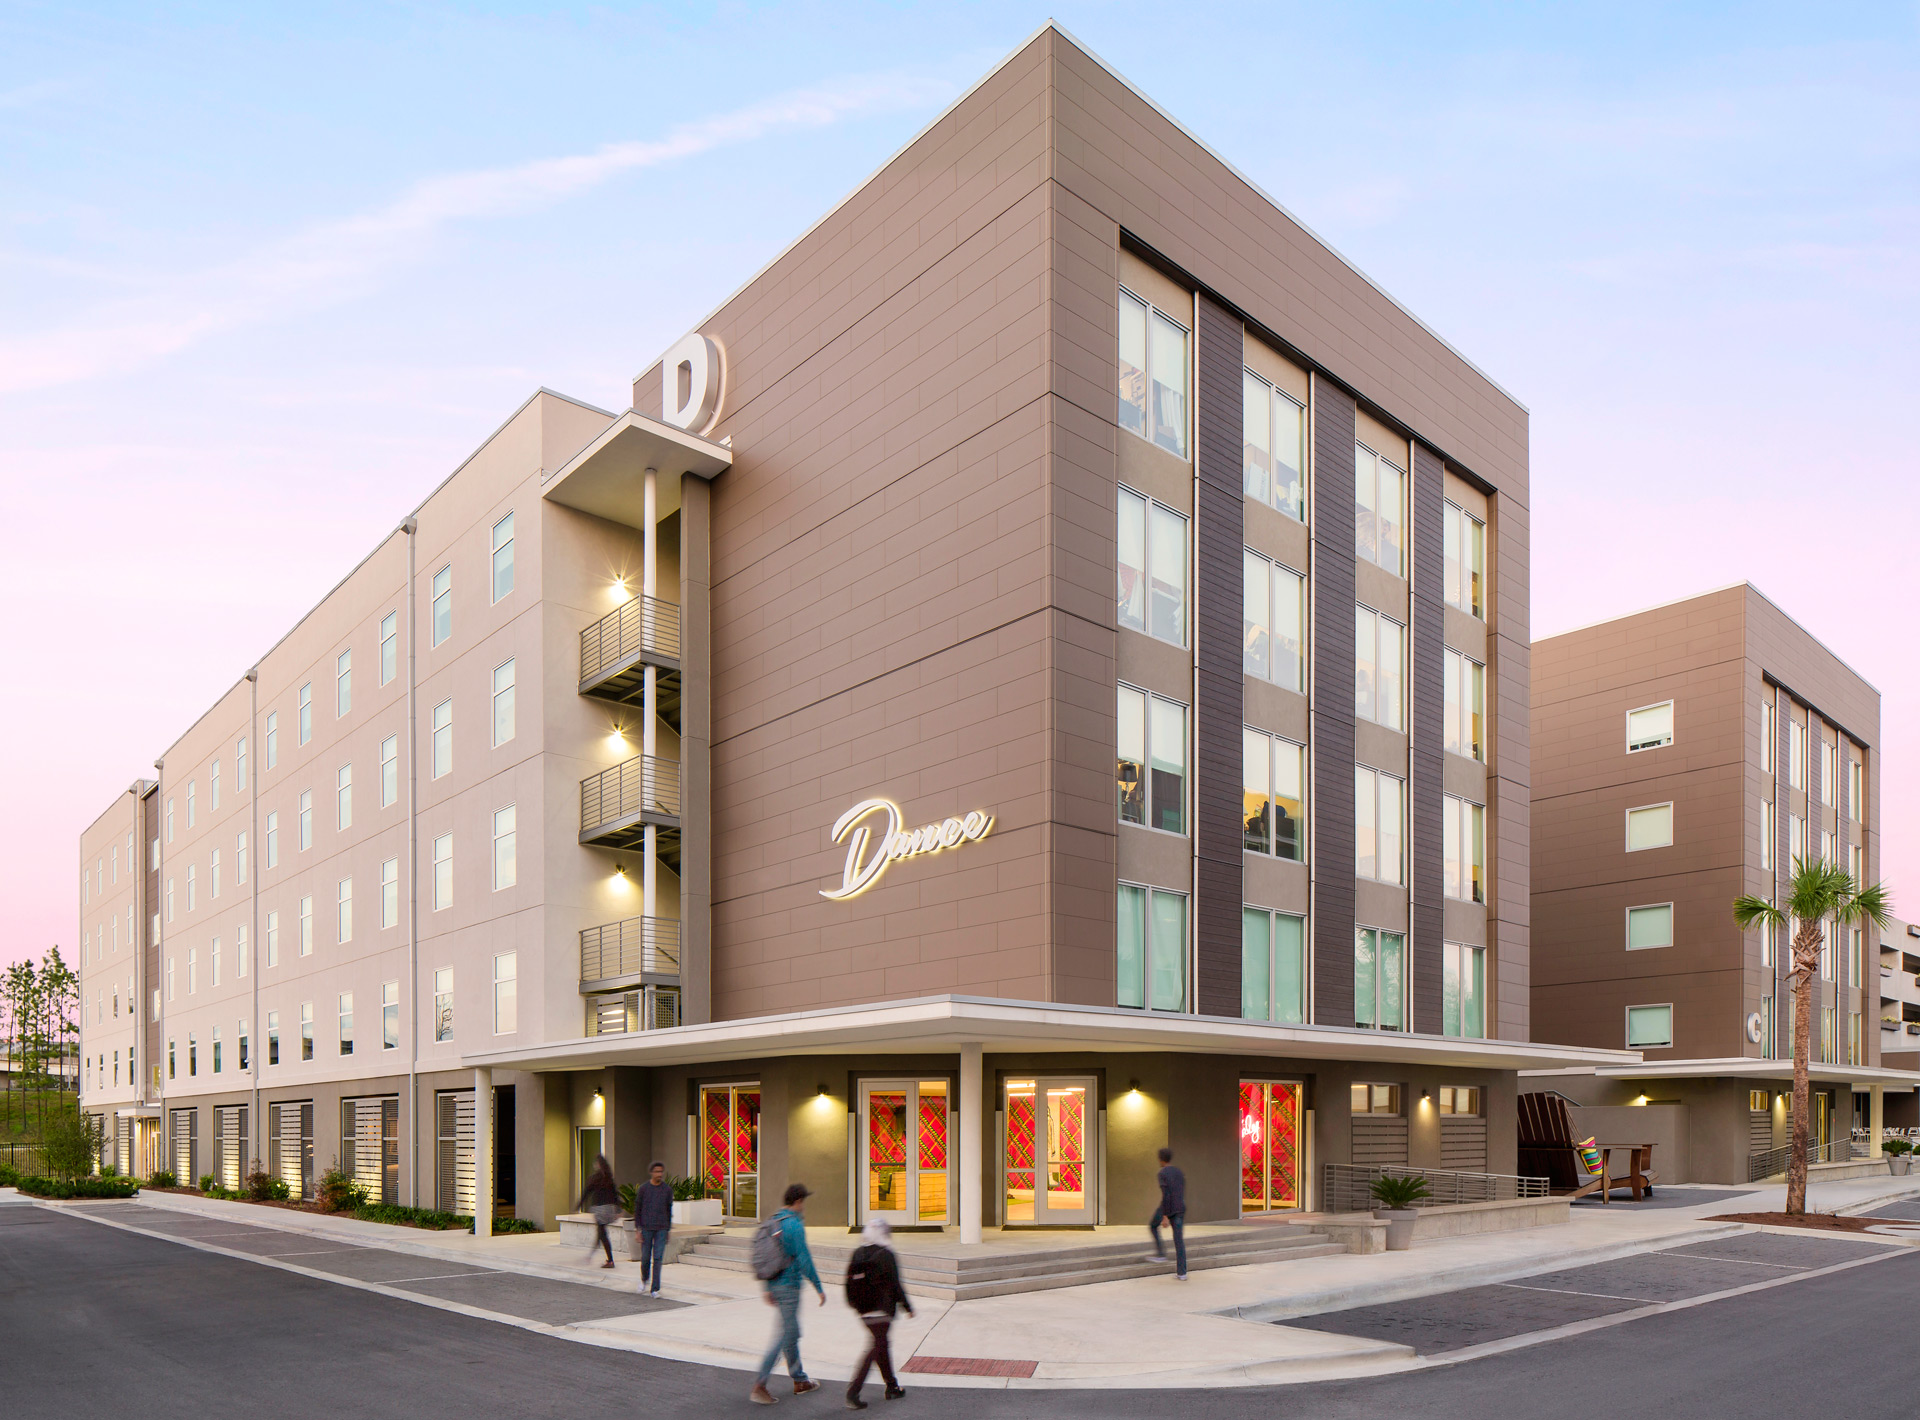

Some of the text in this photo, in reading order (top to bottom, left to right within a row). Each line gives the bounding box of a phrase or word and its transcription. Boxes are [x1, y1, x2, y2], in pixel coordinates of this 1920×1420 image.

[662, 332, 719, 433] D
[818, 799, 992, 899] Dance
[1747, 1012, 1762, 1043] C
